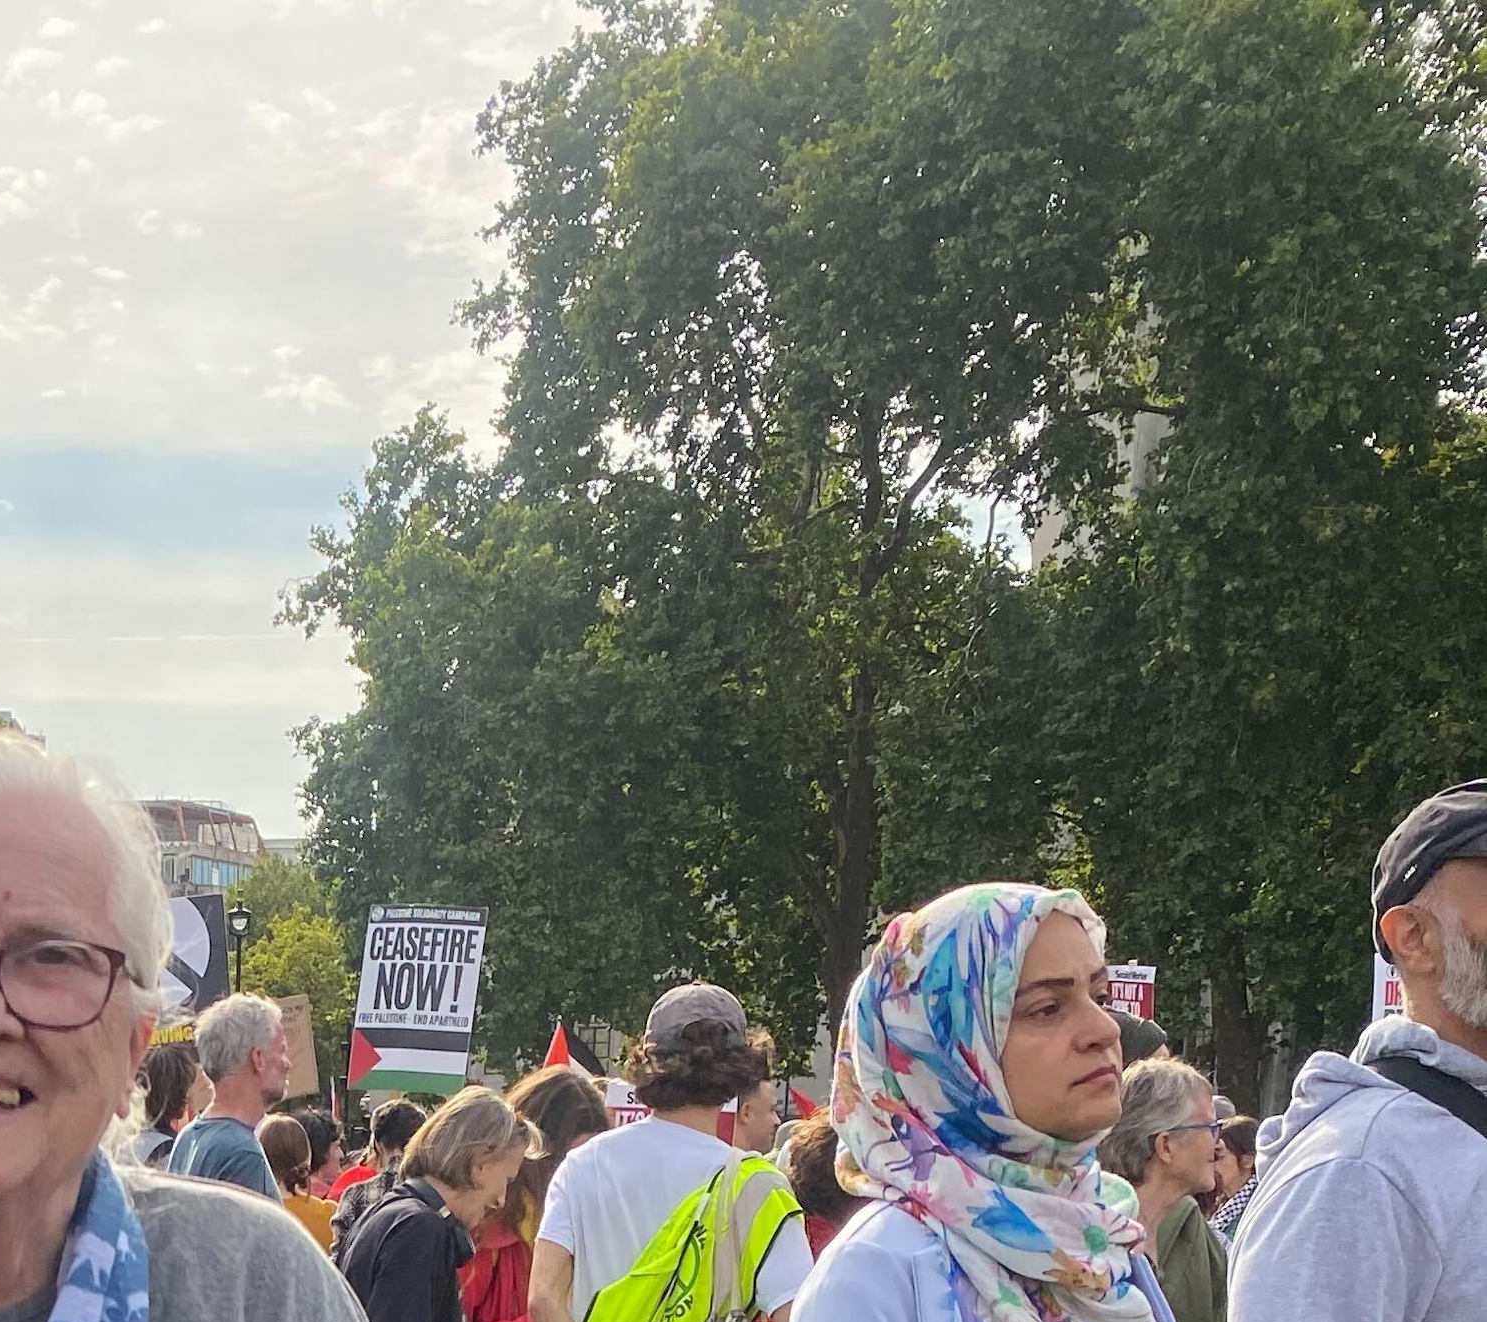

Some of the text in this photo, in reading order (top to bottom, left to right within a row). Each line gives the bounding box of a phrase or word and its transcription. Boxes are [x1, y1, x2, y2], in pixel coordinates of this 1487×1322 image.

[370, 926, 479, 963] CEASEFIRE
[373, 962, 463, 1013] NOW!
[413, 1014, 428, 1025] END
[429, 1015, 469, 1028] APARTHEID
